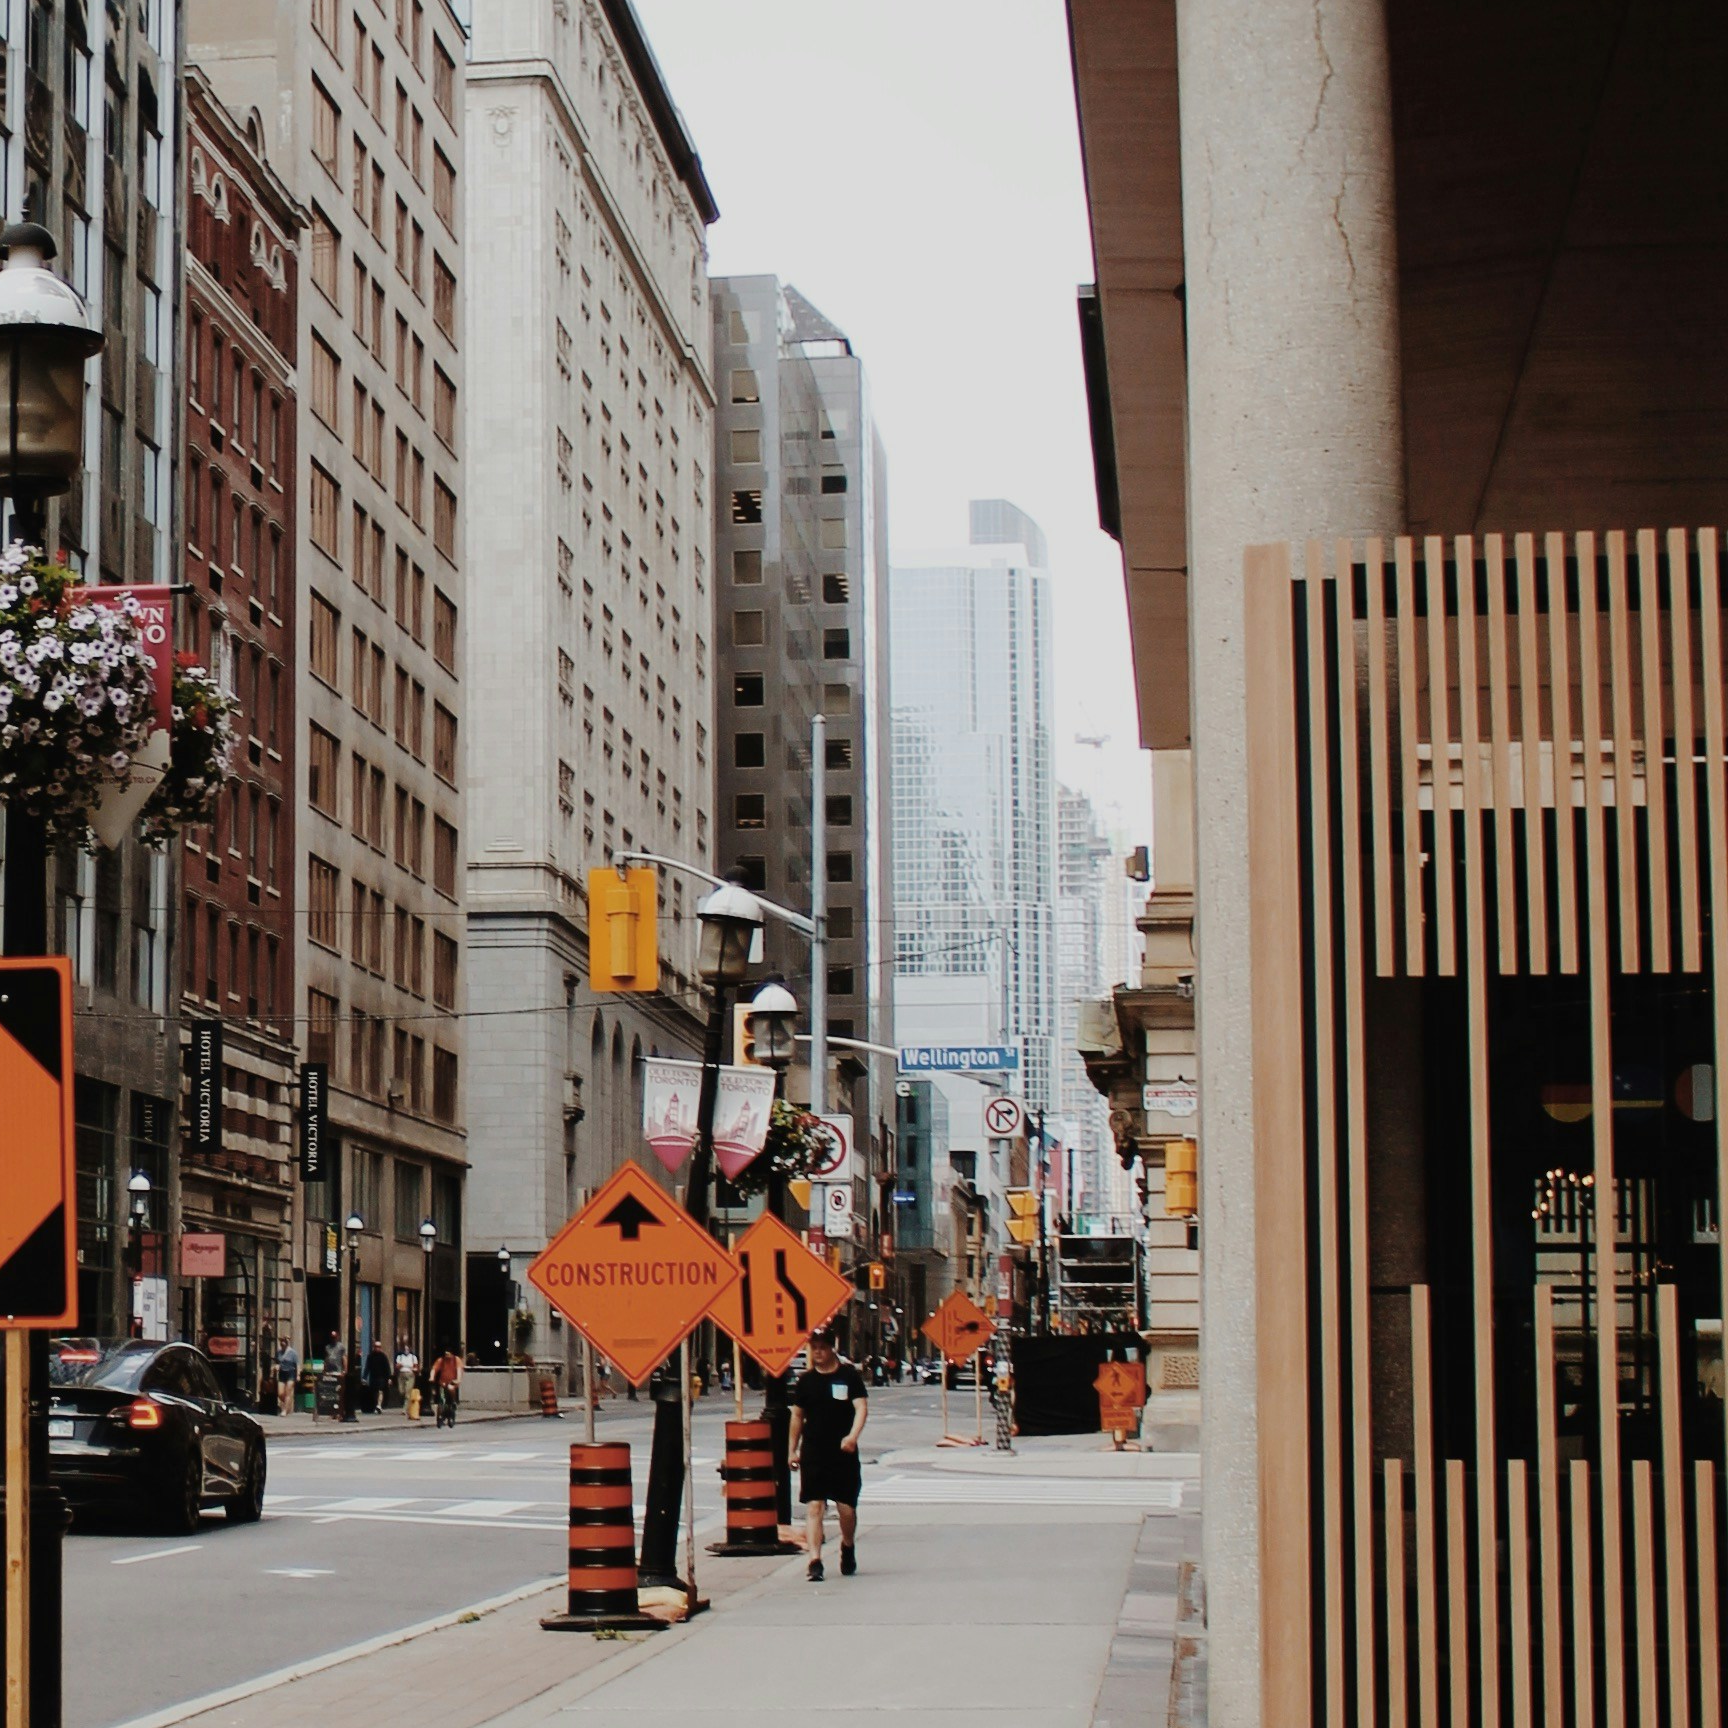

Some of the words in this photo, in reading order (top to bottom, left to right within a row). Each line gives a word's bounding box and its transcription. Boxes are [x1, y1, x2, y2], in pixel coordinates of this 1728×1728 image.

[200, 1030, 212, 1074] HOTEL
[903, 1048, 1000, 1069] Wellington
[308, 1072, 318, 1111] HOTEL
[648, 1075, 699, 1087] TORONTO
[720, 1083, 771, 1096] TORONTO
[199, 1078, 211, 1142] VICTORIA
[307, 1114, 318, 1172] VICTORIA
[546, 1262, 718, 1286] CONSTRUCTION
